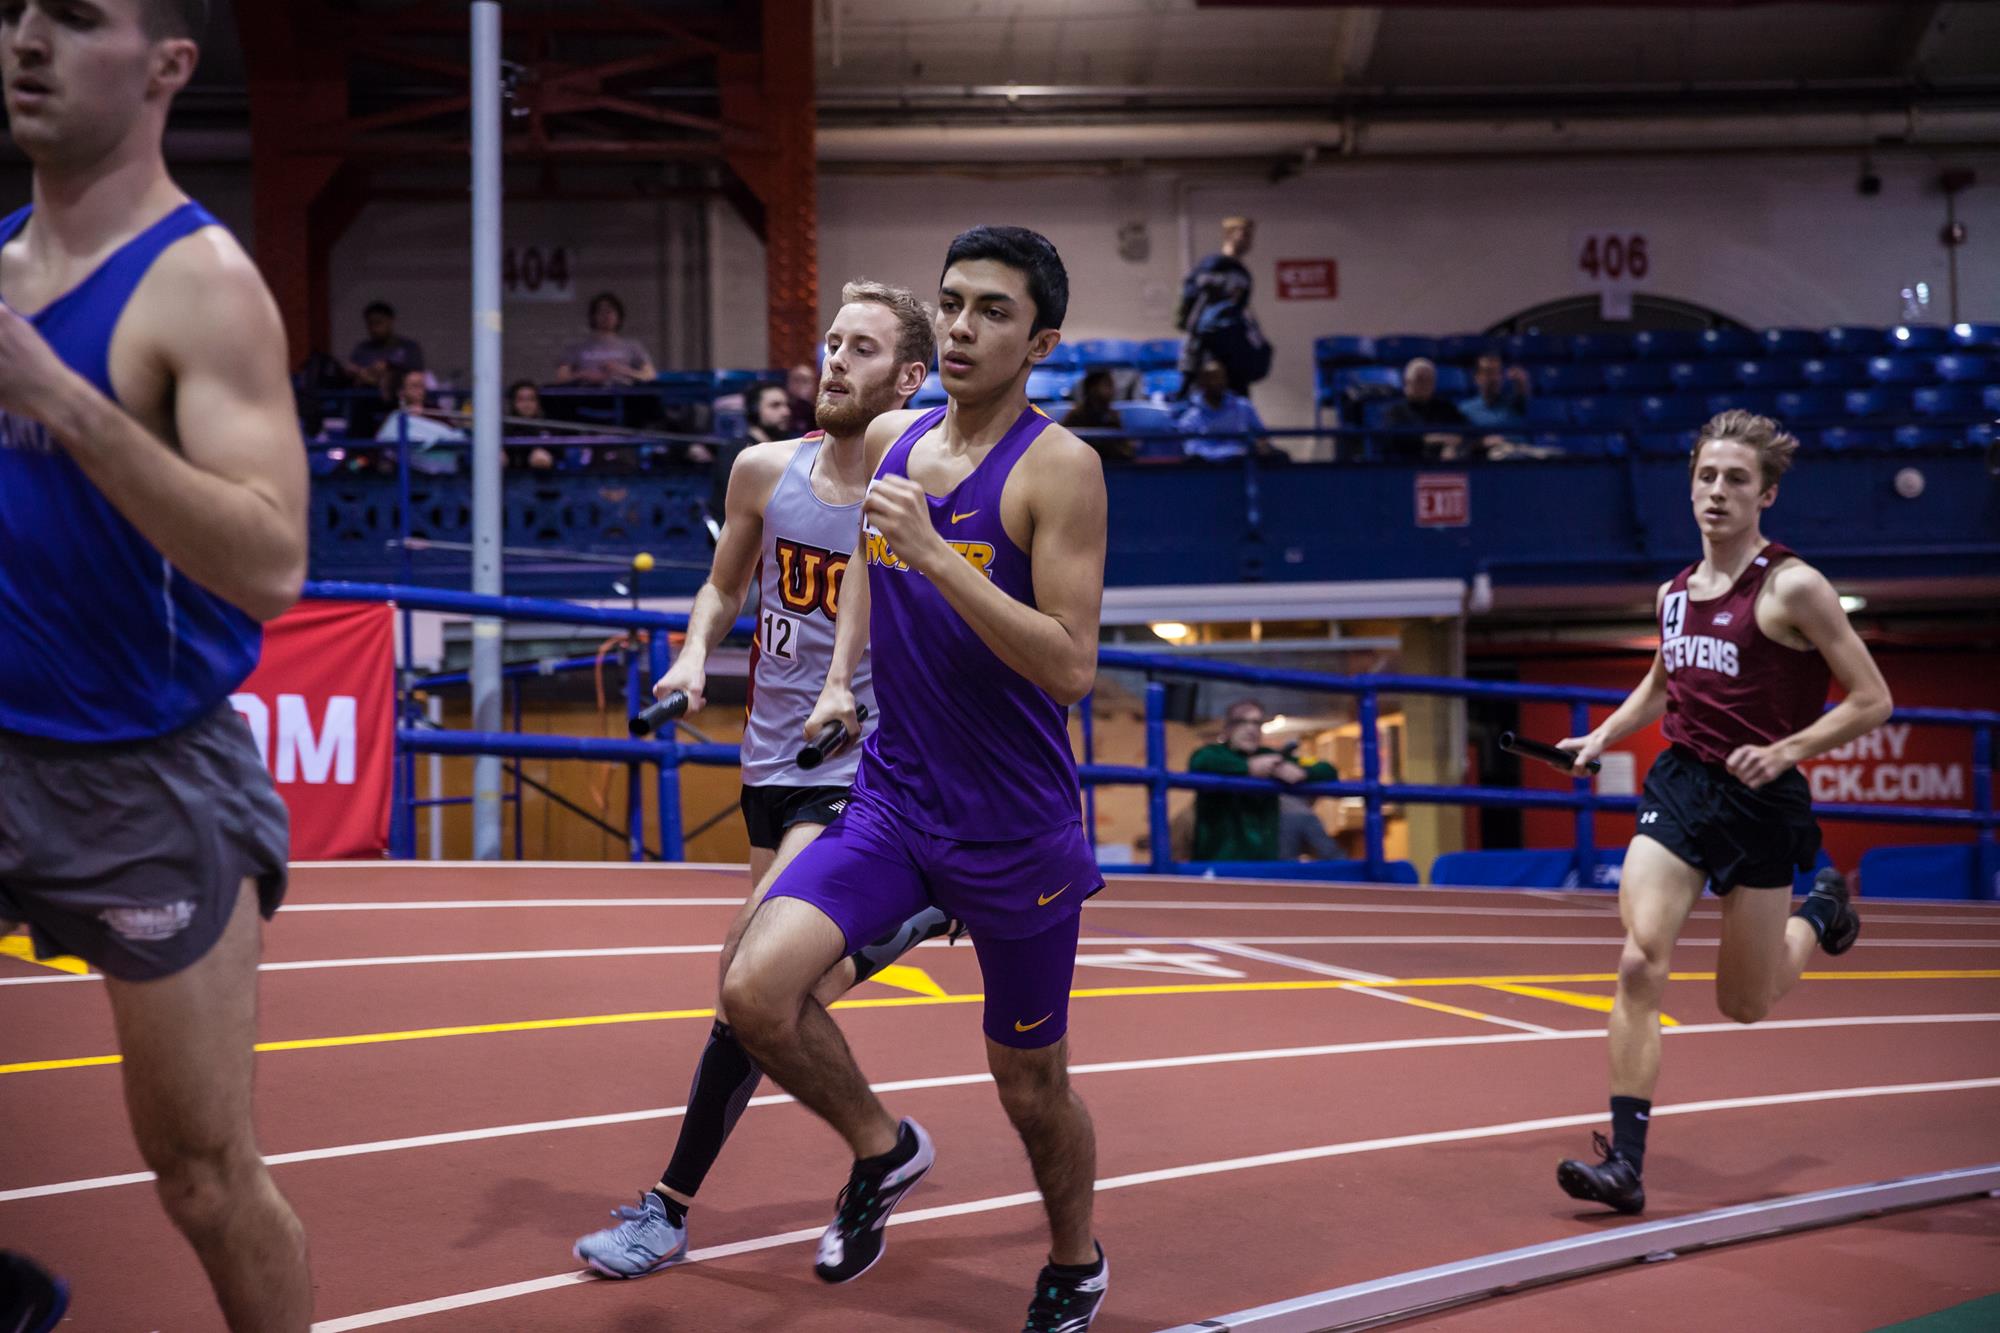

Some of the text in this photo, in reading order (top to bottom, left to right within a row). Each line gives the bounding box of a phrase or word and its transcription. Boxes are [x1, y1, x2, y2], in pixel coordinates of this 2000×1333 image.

[1579, 235, 1648, 279] 406
[1418, 490, 1465, 518] EXIT
[1666, 596, 1681, 634] 4
[764, 613, 792, 659] 12
[1662, 635, 1740, 677] STEVENS
[1797, 763, 1964, 801] CK.COM
